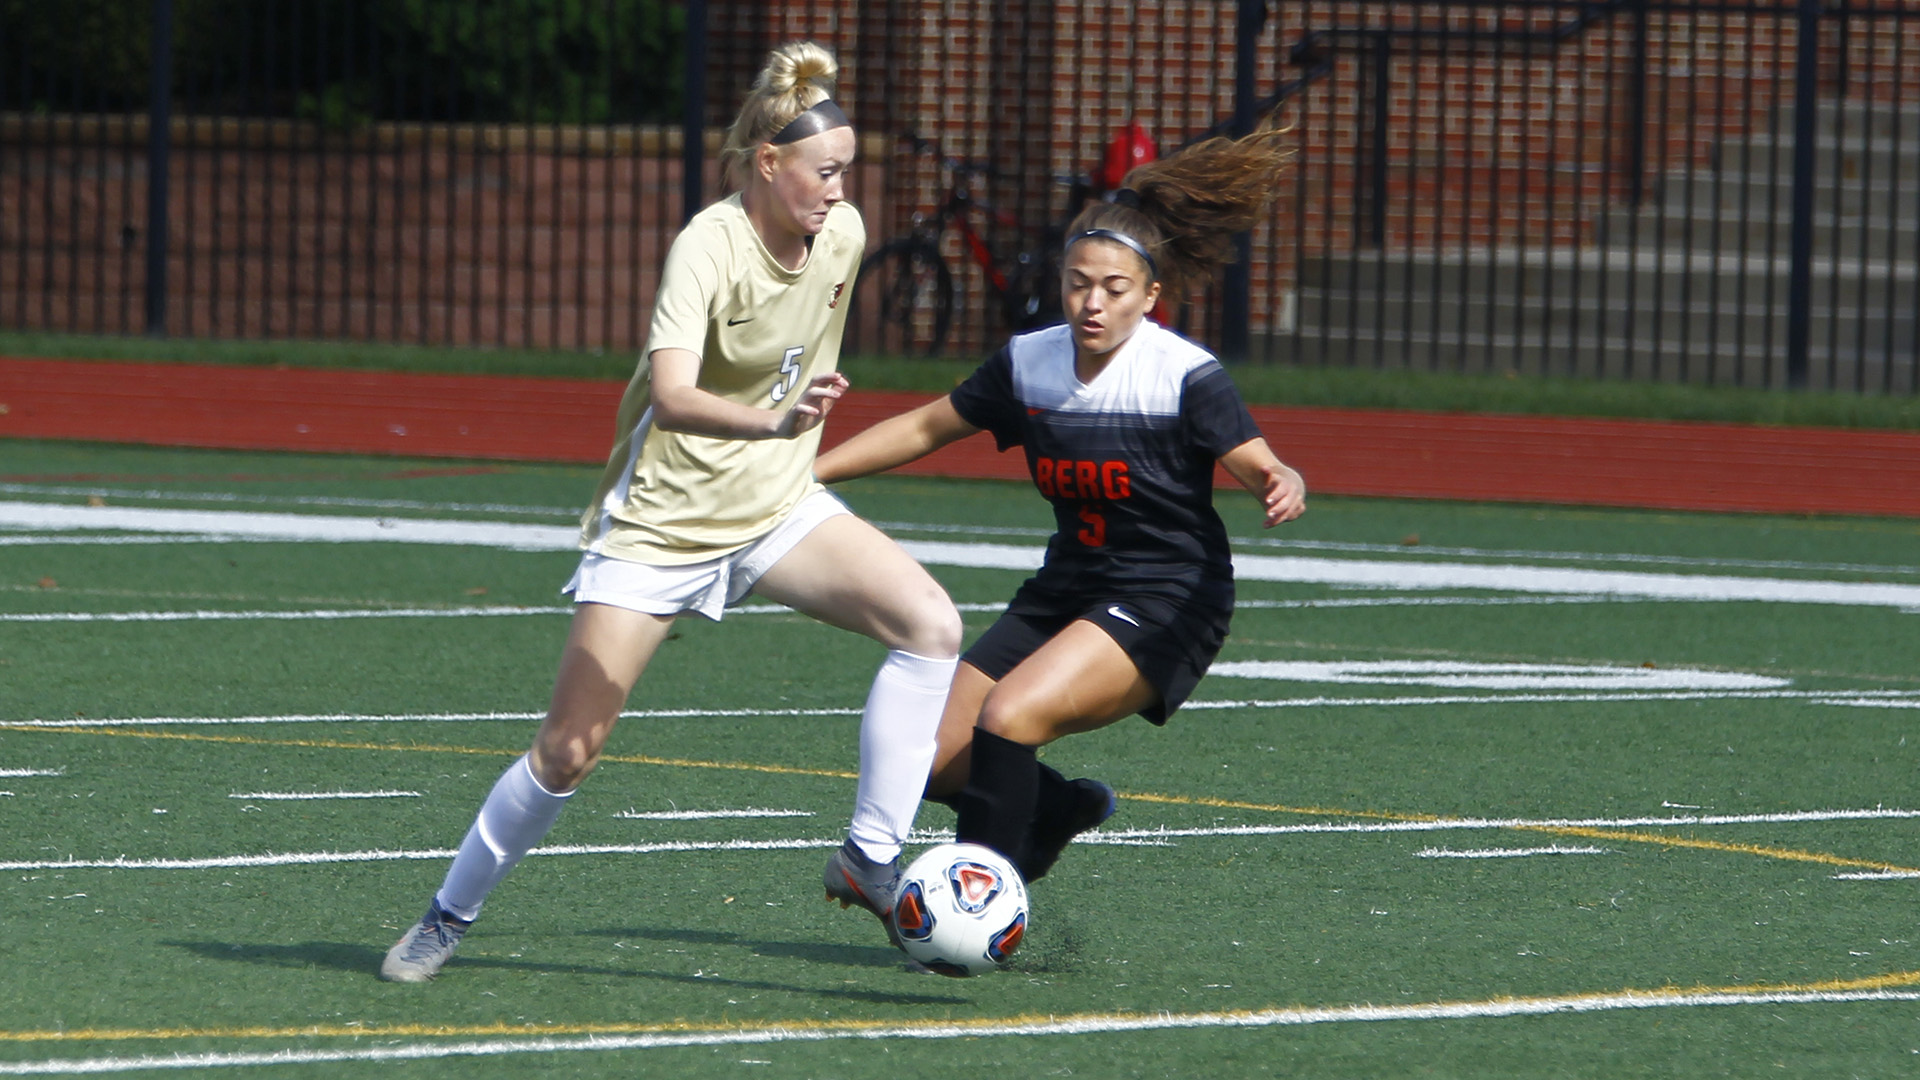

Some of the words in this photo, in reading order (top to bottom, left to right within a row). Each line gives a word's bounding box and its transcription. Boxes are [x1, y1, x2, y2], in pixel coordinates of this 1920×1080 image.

[770, 345, 805, 402] 5
[1036, 457, 1132, 500] BERG
[1077, 504, 1107, 548] 5
